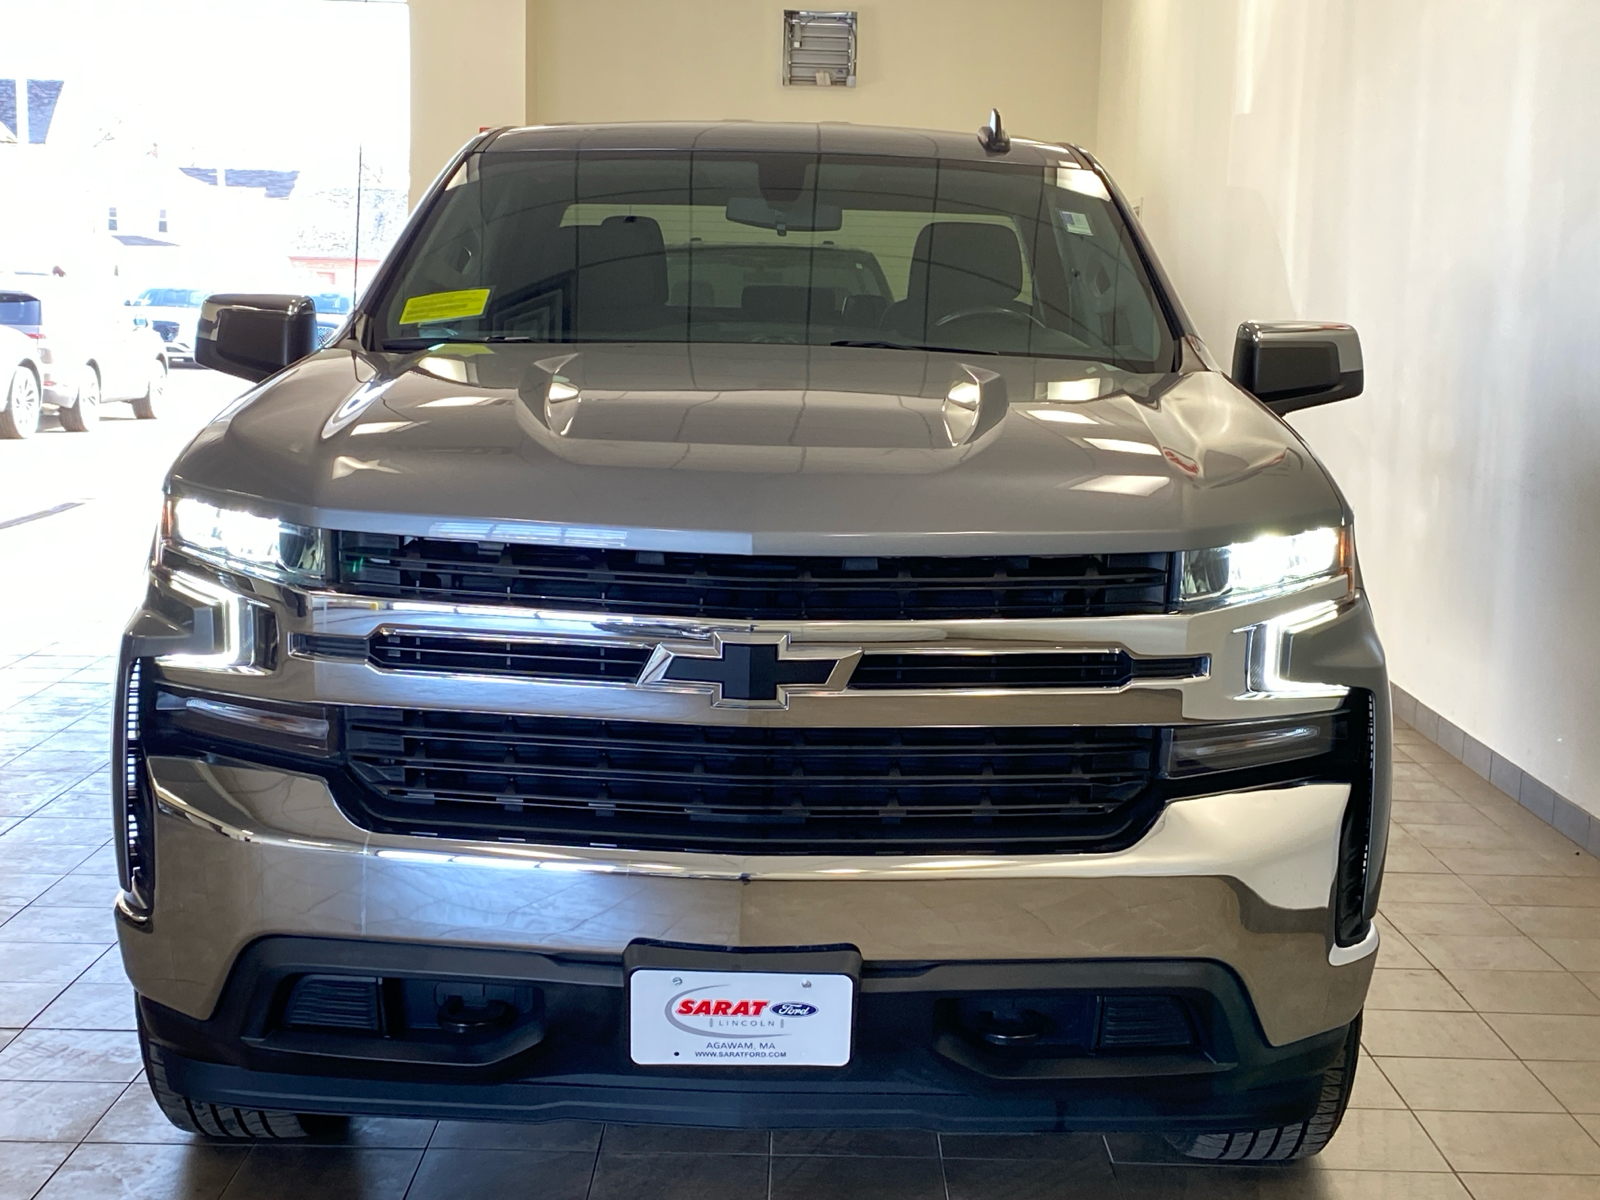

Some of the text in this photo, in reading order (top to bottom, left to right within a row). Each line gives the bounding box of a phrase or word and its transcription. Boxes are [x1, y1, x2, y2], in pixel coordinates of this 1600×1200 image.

[677, 998, 769, 1017] SARAT
[778, 1003, 810, 1015] Ford
[718, 1019, 775, 1027] LINCOLN
[705, 1042, 776, 1050] AGAWAM, MA
